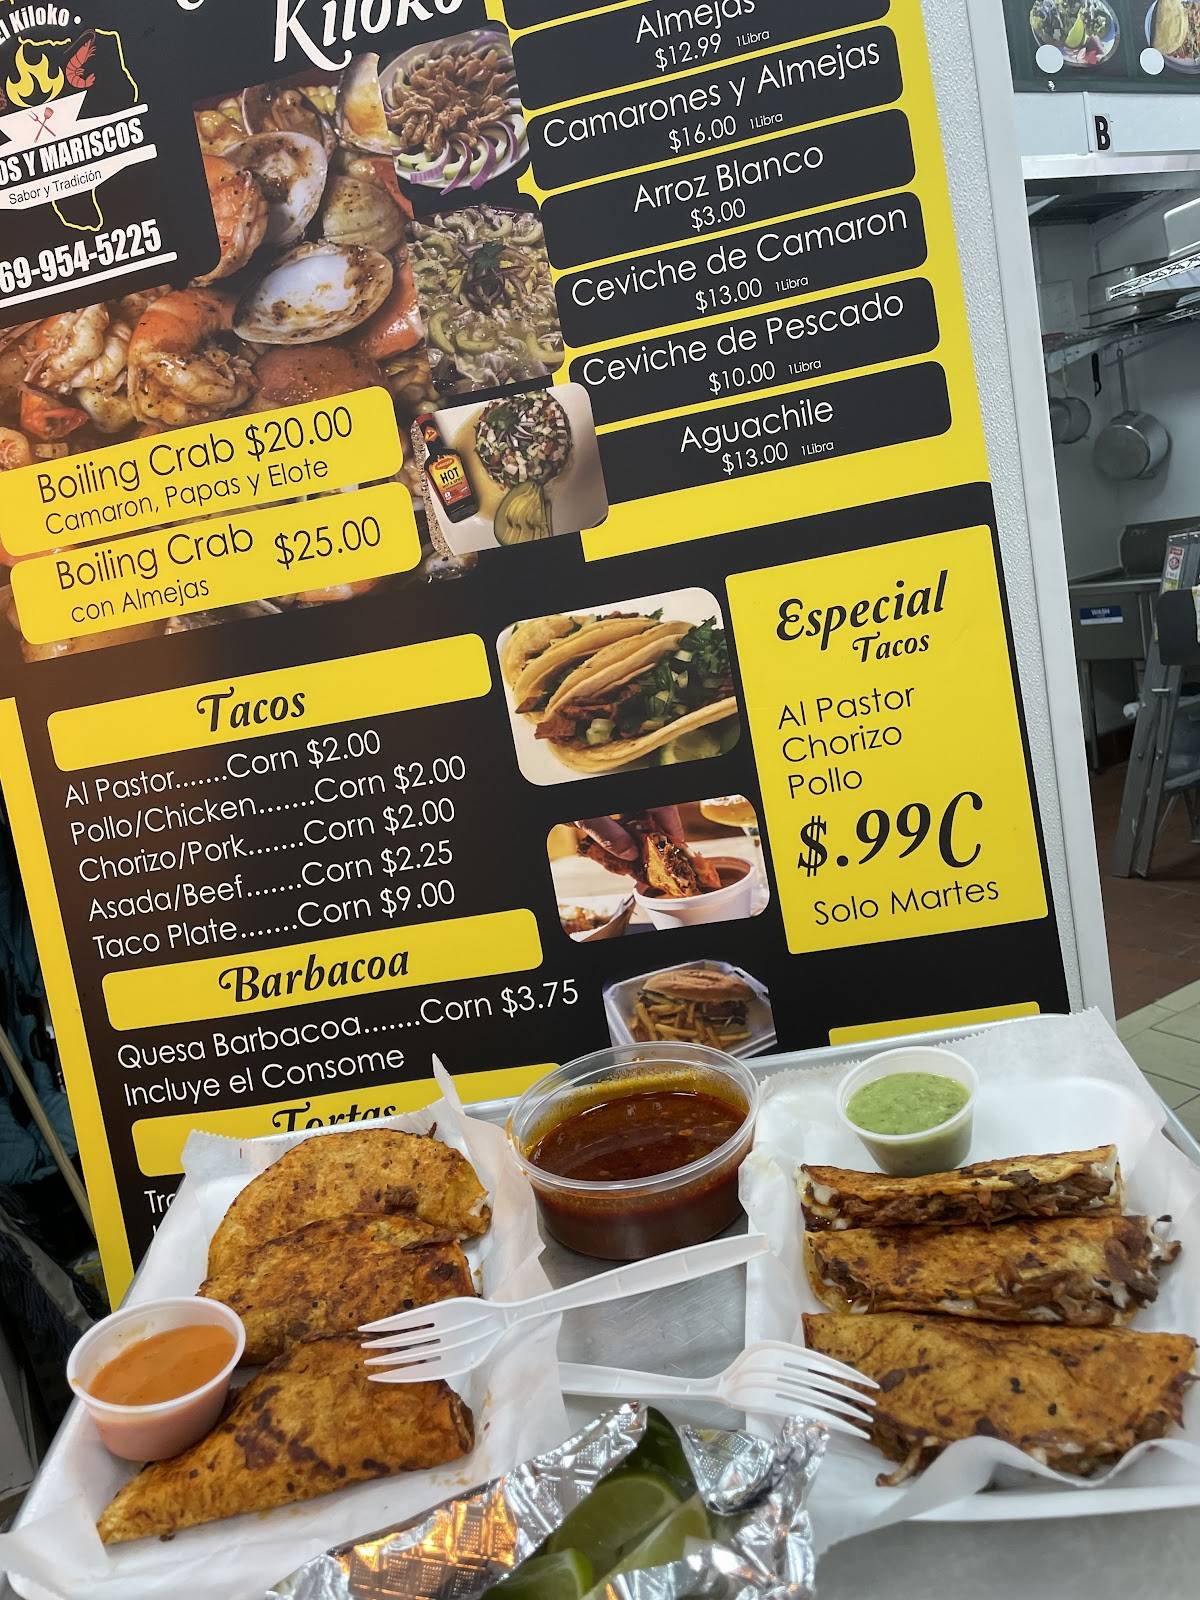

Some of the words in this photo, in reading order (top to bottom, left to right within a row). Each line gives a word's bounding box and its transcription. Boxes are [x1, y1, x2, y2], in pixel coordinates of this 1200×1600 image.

[9, 3, 70, 34] Kiloko
[635, 0, 756, 44] Almejas
[655, 32, 722, 72] $12.99
[543, 84, 722, 148] Camarones
[728, 76, 746, 107] y
[757, 42, 880, 94] Almejas
[22, 150, 36, 177] Y
[38, 117, 144, 173] MARISCOS
[668, 115, 737, 154] $16.00
[1094, 115, 1111, 150] B
[8, 188, 41, 205] Sabor
[43, 185, 50, 199] y
[51, 170, 102, 192] Tradición
[633, 175, 710, 213] Arroz
[715, 146, 824, 192] Blanco
[690, 197, 746, 233] $3.00
[0, 218, 162, 294] 69-954-5225
[571, 259, 697, 307] Ceviche
[706, 245, 747, 275] de
[756, 208, 908, 262] Camaron
[695, 277, 763, 314] $13.00
[583, 340, 707, 386] Ceviche
[716, 326, 757, 356] de
[766, 292, 904, 345] Pescado
[708, 360, 776, 396] $10.00
[680, 398, 834, 454] Aguachile
[37, 459, 140, 504] Boiling
[149, 433, 235, 476] Crab
[245, 406, 352, 462] $20.00
[440, 466, 459, 484] HOT
[721, 441, 789, 476] $13.00
[45, 497, 159, 535] Camaron,
[164, 477, 241, 508] Papas
[246, 473, 260, 497] y
[267, 458, 328, 487] Elote
[55, 548, 158, 590] Boiling
[167, 523, 253, 565] Crab
[274, 516, 381, 570] $25.00
[71, 600, 115, 623] con
[122, 579, 209, 613] Almejas
[776, 569, 949, 651] Especial
[852, 631, 930, 663] Tacos
[196, 686, 306, 732] Tacos
[778, 701, 807, 730] Al
[816, 687, 915, 723] Pastor
[782, 726, 902, 763] Chorizo
[65, 781, 89, 809] Al
[306, 729, 381, 770] $2.00
[393, 755, 466, 795] $2.00
[787, 767, 863, 799] Pollo
[382, 797, 455, 836] $2.00
[380, 839, 453, 878] $2.25
[92, 933, 160, 960] Taco
[379, 879, 455, 919] $9.00
[813, 895, 879, 926] Solo
[891, 880, 999, 915] Martes
[218, 951, 409, 1003] Barbacoa
[117, 1040, 206, 1069] Quesa
[500, 978, 579, 1018] $3.75
[123, 1077, 221, 1107] Incluye
[229, 1067, 254, 1094] el
[261, 1049, 405, 1089] Consome
